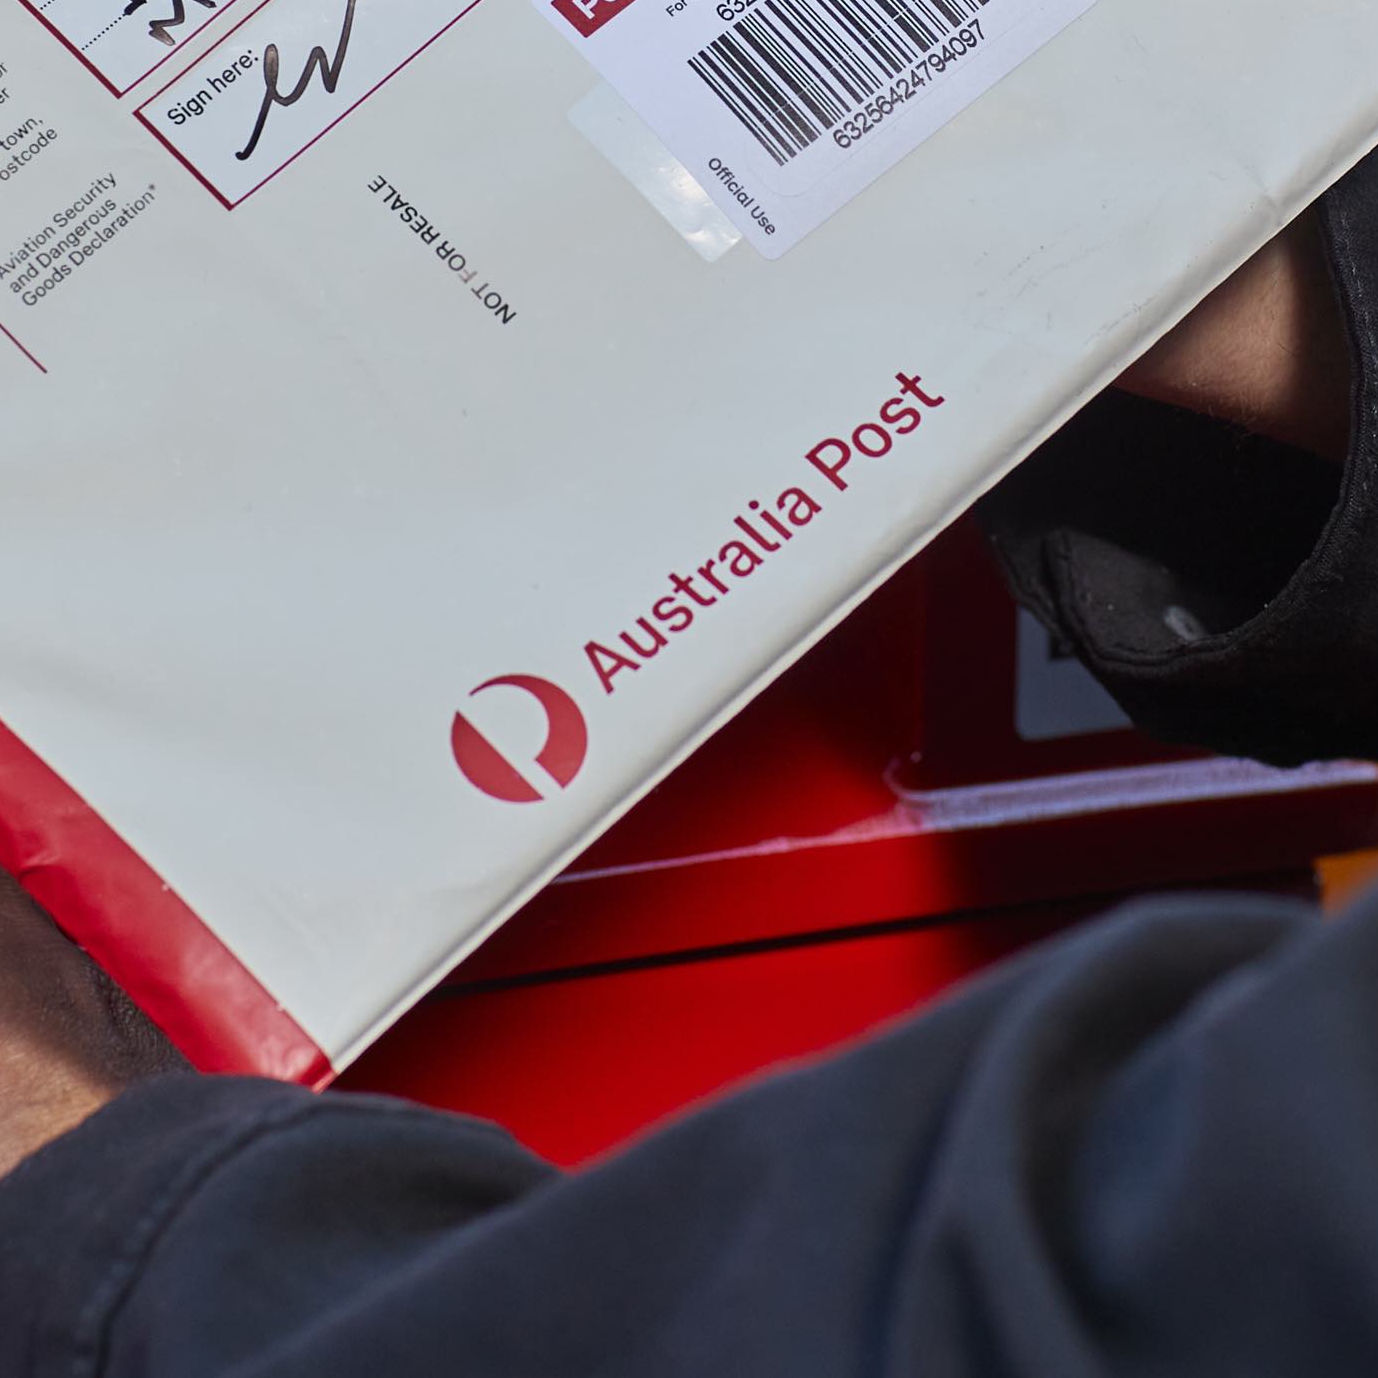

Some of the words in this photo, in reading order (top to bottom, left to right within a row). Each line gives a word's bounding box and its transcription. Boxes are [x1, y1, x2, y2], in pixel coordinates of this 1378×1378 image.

[167, 90, 213, 124] Sign
[206, 49, 265, 92] here:
[832, 18, 985, 148] 63256424794097
[52, 173, 117, 227] Security
[367, 175, 441, 244] RESALE
[708, 157, 755, 207] Official
[750, 205, 776, 235] Use
[9, 262, 39, 293] and
[35, 199, 117, 268] Dangerous
[435, 240, 478, 283] FOR
[21, 264, 72, 305] Goods
[471, 283, 517, 324] NOT
[583, 487, 822, 694] Australia
[804, 372, 945, 491] Post
